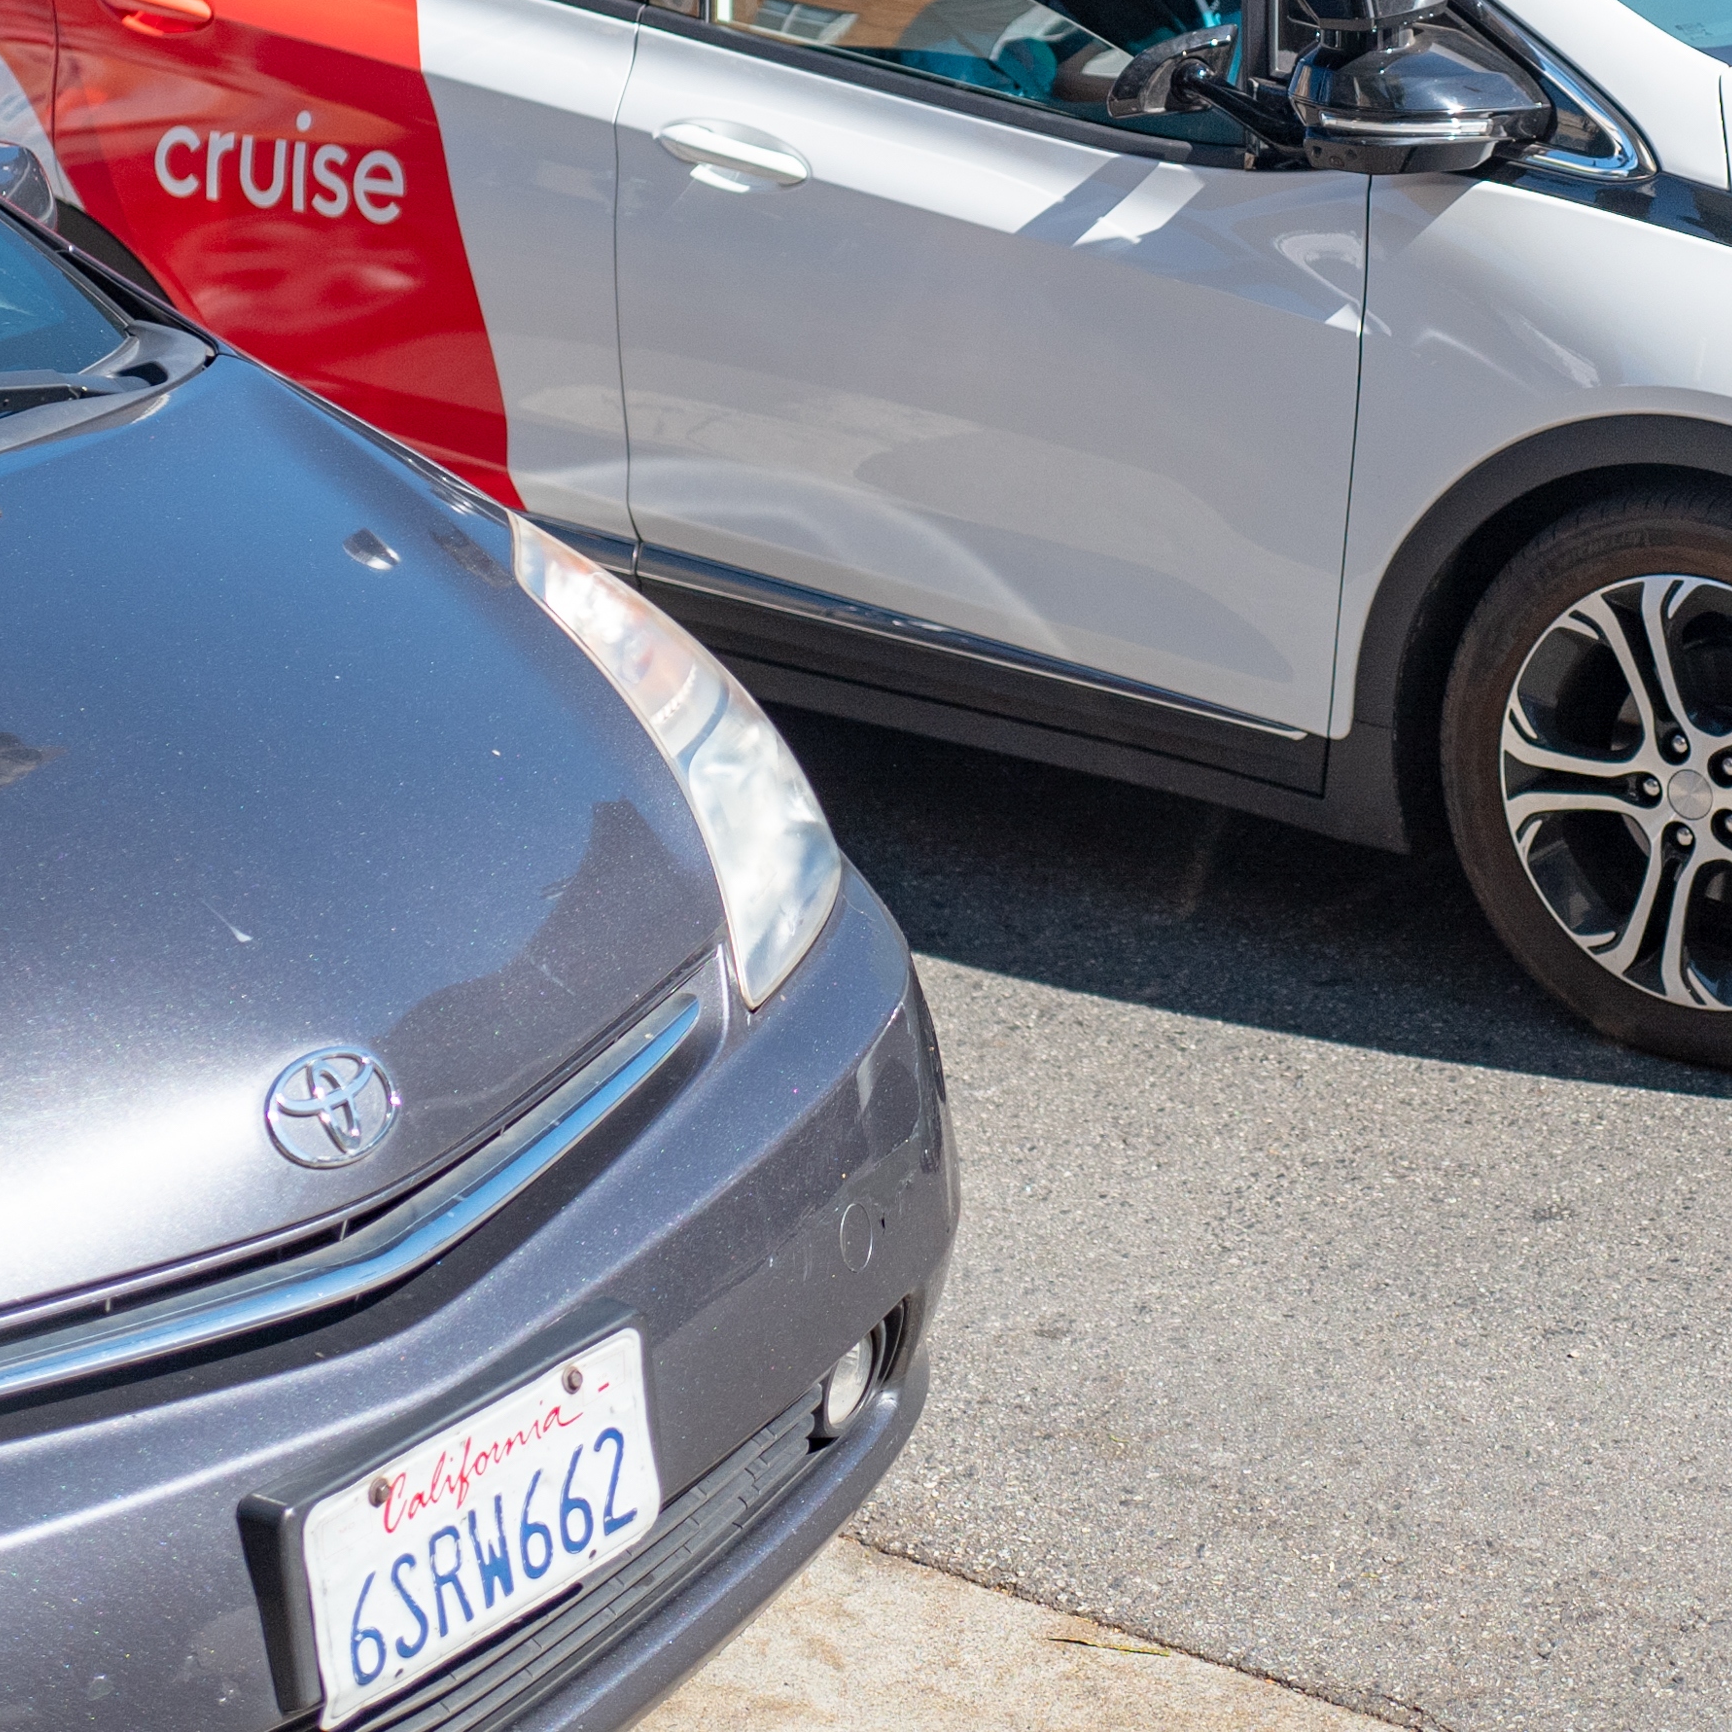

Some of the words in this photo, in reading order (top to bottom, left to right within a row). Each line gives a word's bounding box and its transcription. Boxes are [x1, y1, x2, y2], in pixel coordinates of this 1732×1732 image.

[154, 110, 406, 225] cruise
[383, 1400, 583, 1534] California
[349, 1427, 638, 1686] 6SRW662
